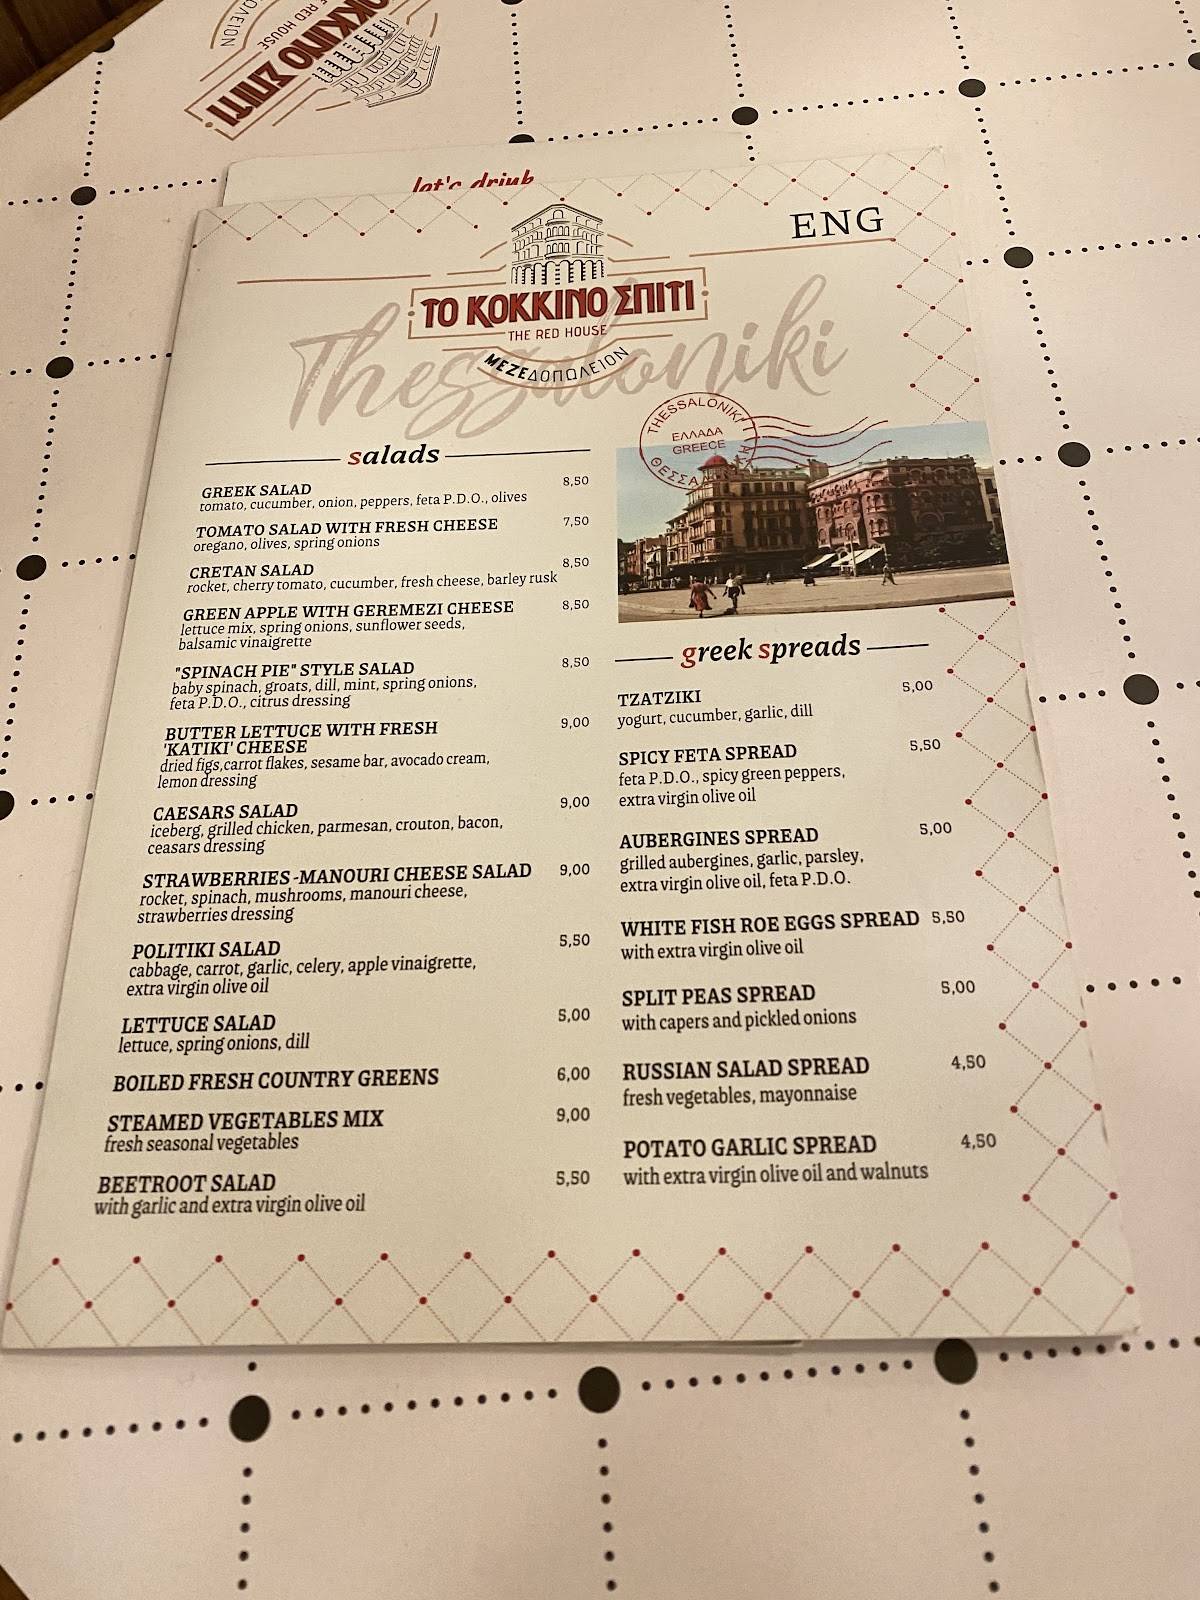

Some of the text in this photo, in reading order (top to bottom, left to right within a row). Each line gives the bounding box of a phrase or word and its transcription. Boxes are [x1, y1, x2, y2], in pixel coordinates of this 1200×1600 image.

[256, 3, 319, 50] RED HOUSE
[791, 207, 885, 240] ENG
[419, 279, 696, 330] ΤΟ ΚΟΚΚΙΝΟ ΣΠΙΤΙ
[508, 324, 608, 342] THE RED HOUSE
[672, 427, 724, 442] ΕΛΛΑΔΑ
[347, 443, 441, 467] salads
[673, 439, 727, 455] GREECE
[562, 475, 589, 487] 8,50
[201, 483, 312, 499] GREEK SALAD
[199, 490, 527, 512] tomato, cucumber, onion, peppers, feta P.D.O., olives
[195, 517, 498, 539] TOMATO SALAD WITH FRESH CHEESE
[562, 515, 589, 528] 7,50
[192, 535, 380, 554] oregano, olives, spring onions
[189, 563, 314, 580] CRETAN SALAD
[562, 556, 589, 569] 8,50
[186, 570, 558, 594] rocket, cherry tomato, cucumber, fresh cheese, barley rusk
[182, 600, 514, 622] GREEN APPLE WITH GEREMEZI CHEESE
[562, 599, 590, 611] 8,50
[680, 633, 862, 669] greek spreads
[175, 661, 415, 680] "SPINACH PIE" STYLE SALAD
[561, 656, 590, 669] 8,50
[902, 679, 933, 693] 5,00
[169, 692, 352, 711] feta P.D.O., citrus dressing
[617, 689, 702, 707] TZATZIKI
[560, 716, 590, 730] 9,00
[616, 702, 814, 730] yogurt, cucumber, garlic, dill
[164, 720, 438, 741] BUTTER LETTUCE WITH FRESH
[163, 739, 308, 757] 'KATIKI' CHEESE
[618, 743, 797, 766] SPICY FETA SPREAD
[909, 738, 941, 752] 5,50
[560, 795, 590, 810] 9,00
[152, 803, 298, 822] CAESARS SALAD
[618, 827, 819, 849] AUBERGINES SPREAD
[919, 821, 952, 836] 5,00
[559, 862, 590, 877] 9,00
[620, 910, 920, 937] WHITE FISH ROE EGGS SPREAD
[931, 909, 965, 925] 5,50
[559, 932, 590, 948] 5,50
[130, 940, 281, 960] POLITIKI SALAD
[621, 983, 816, 1007] SPLIT PEAS SPREAD
[940, 979, 976, 996] 5,00
[120, 1013, 276, 1034] LETTUCE SALAD
[557, 1007, 590, 1023] 5,00
[621, 1007, 857, 1034] with capers and pickled onions
[117, 1031, 310, 1056] lettuce, spring onions, dill
[622, 1056, 870, 1081] RUSSIAN SALAD SPREAD
[950, 1054, 986, 1071] 4,50
[111, 1067, 439, 1092] BOILED FRESH COUNTRY GREENS
[557, 1066, 590, 1083] 6,00
[622, 1082, 857, 1110] fresh vegetables, mayonnaise
[106, 1108, 384, 1133] STEAMED VEGETABLES MIX
[556, 1106, 590, 1124] 9,00
[103, 1131, 299, 1155] fresh seasonal vegetables
[622, 1134, 877, 1159] POTATO GARLIC SPREAD
[960, 1132, 997, 1150] 4,50
[96, 1173, 276, 1194] BEETROOT SALAD
[555, 1170, 590, 1187] 5,50
[622, 1160, 929, 1188] with extra virgin olive oil and walnuts
